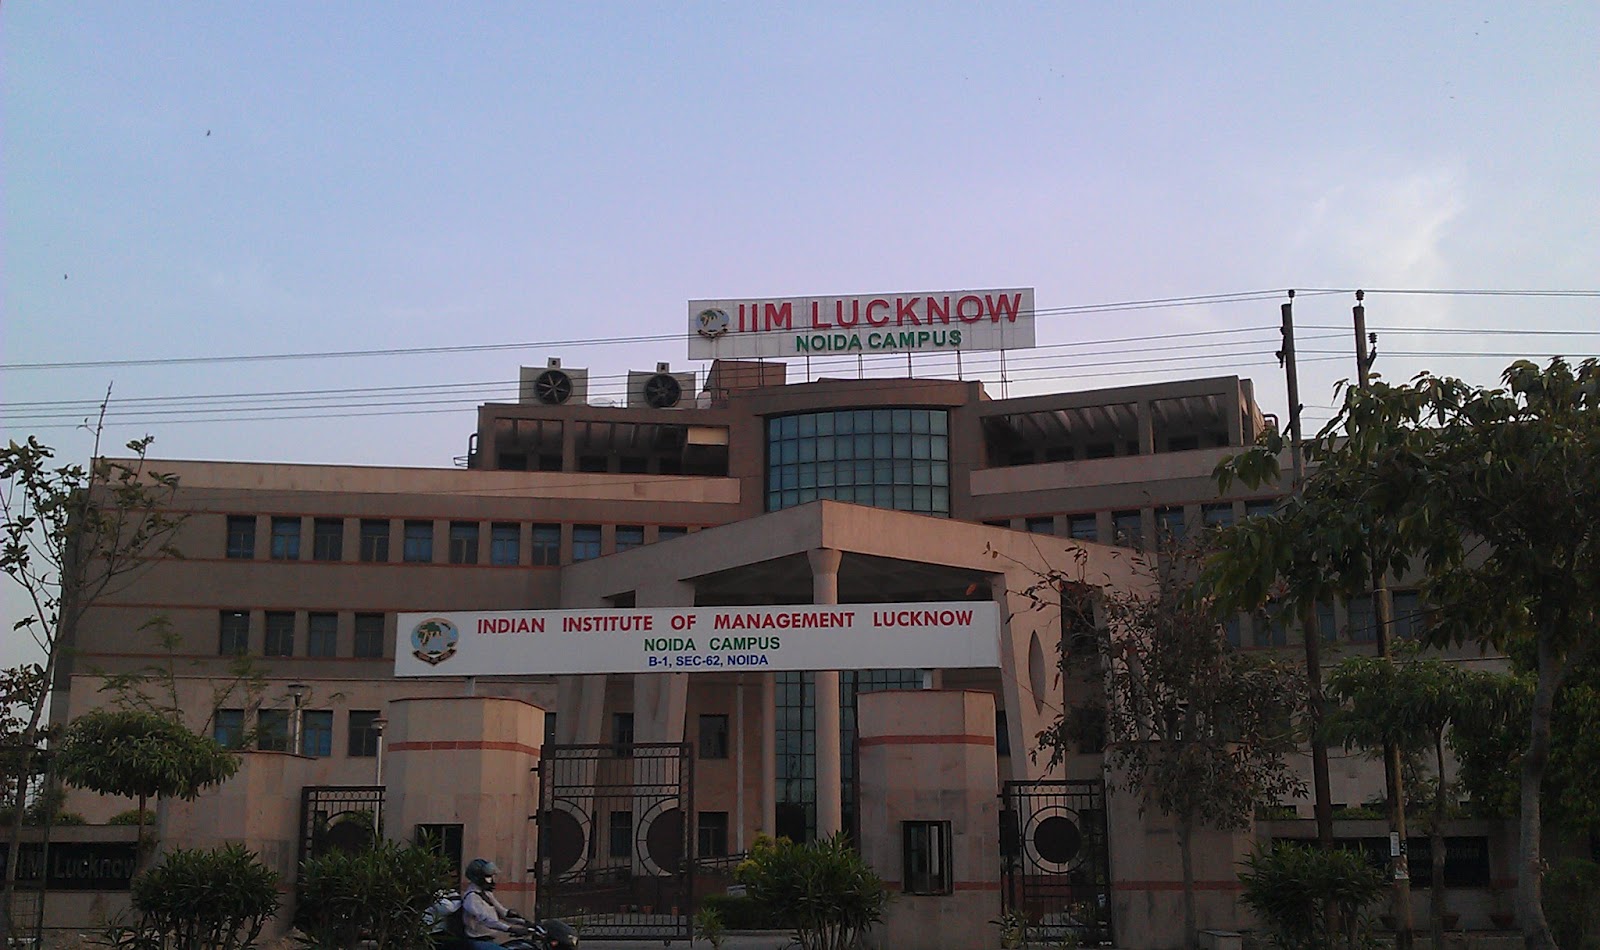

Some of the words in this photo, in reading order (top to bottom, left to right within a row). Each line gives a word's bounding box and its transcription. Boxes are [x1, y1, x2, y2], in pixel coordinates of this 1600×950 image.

[738, 302, 793, 332] IIM
[811, 293, 1022, 329] LUCKNOW
[795, 334, 863, 352] NOIDA
[867, 329, 962, 348] CAMPUS
[477, 618, 545, 634] INDIAN
[563, 615, 653, 632] INSTITUTE
[670, 614, 696, 631] OF
[714, 612, 855, 629] MANAGEMENT
[873, 610, 973, 627] LUCKNOW
[644, 638, 697, 651] NOIDA
[709, 637, 780, 650] CAMPUS
[648, 656, 672, 668] B-1,
[675, 655, 724, 667] SEC-62,
[727, 654, 769, 666] NOIDA
